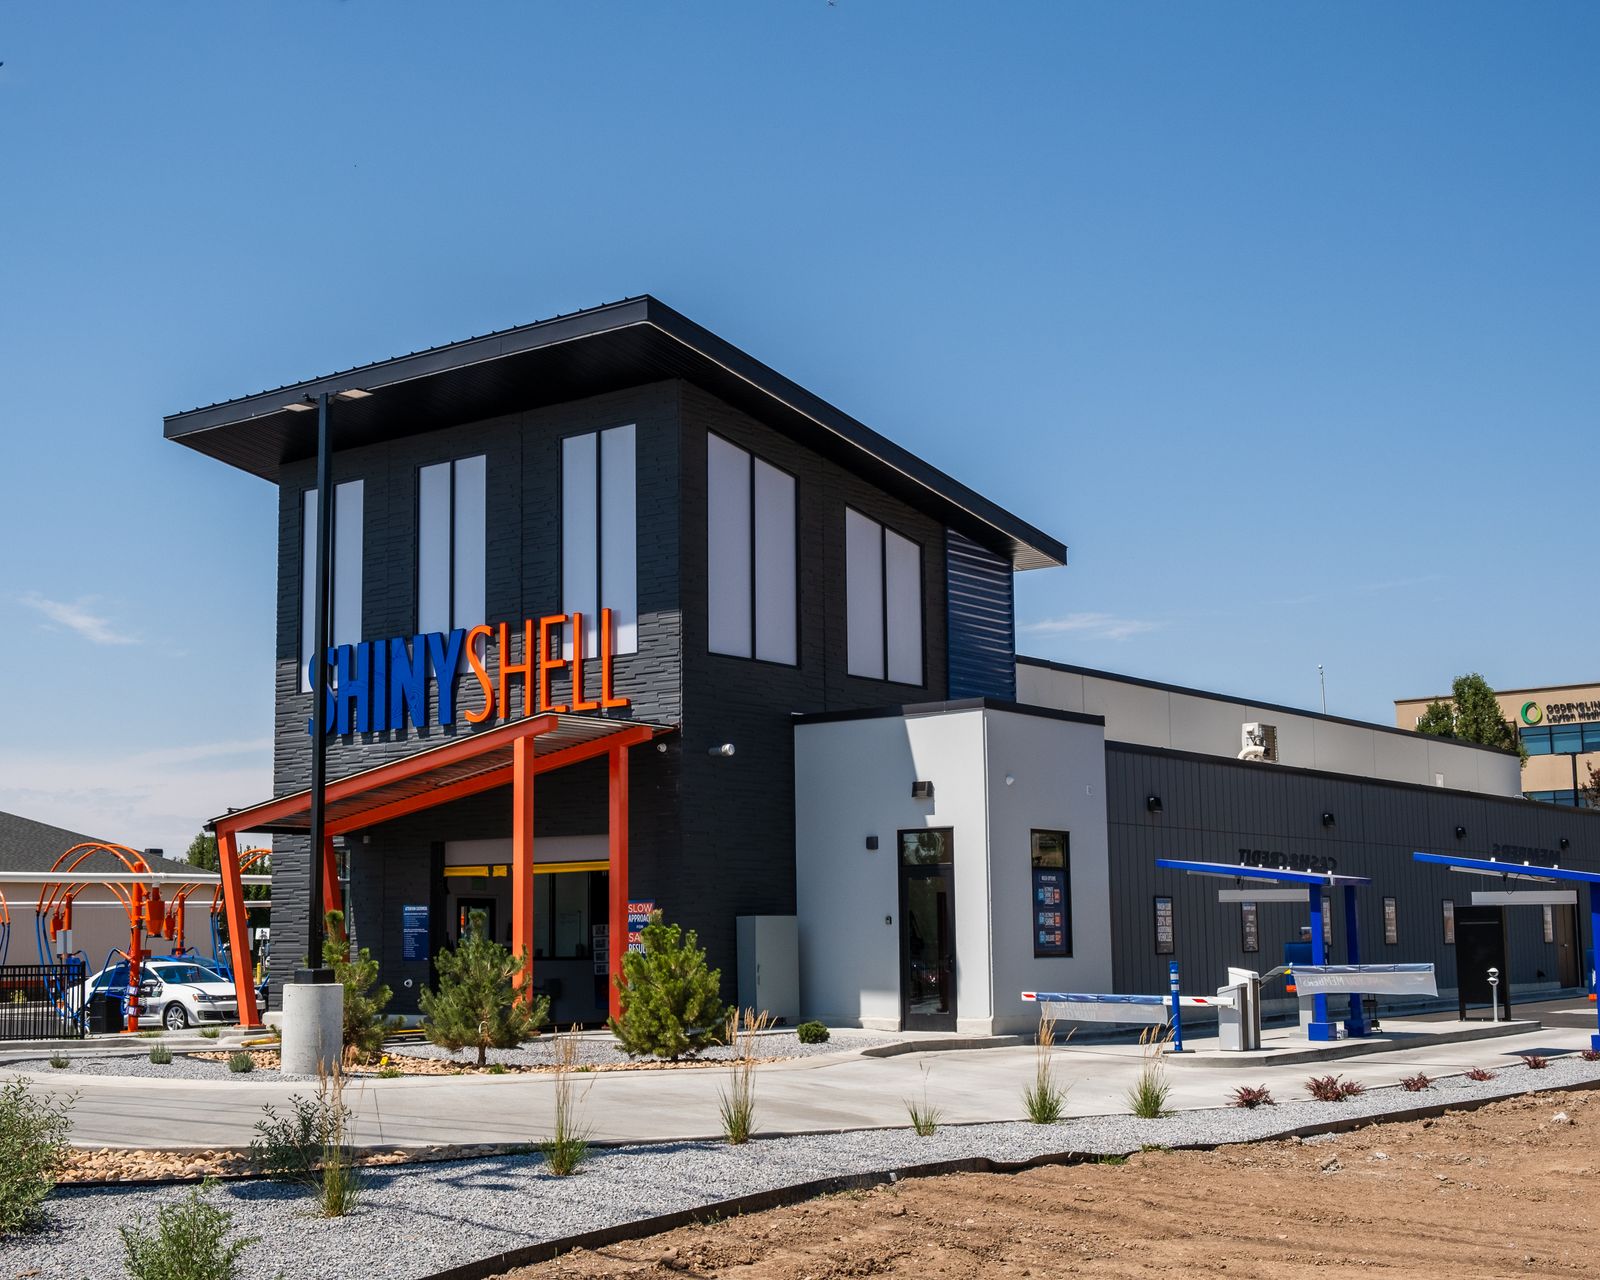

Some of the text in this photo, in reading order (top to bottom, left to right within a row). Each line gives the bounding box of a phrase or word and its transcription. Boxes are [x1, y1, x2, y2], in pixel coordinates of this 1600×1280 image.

[308, 607, 631, 736] SHINY SHELL
[628, 903, 653, 913] SLOW
[628, 933, 641, 943] SA
[629, 944, 647, 954] RESUL
